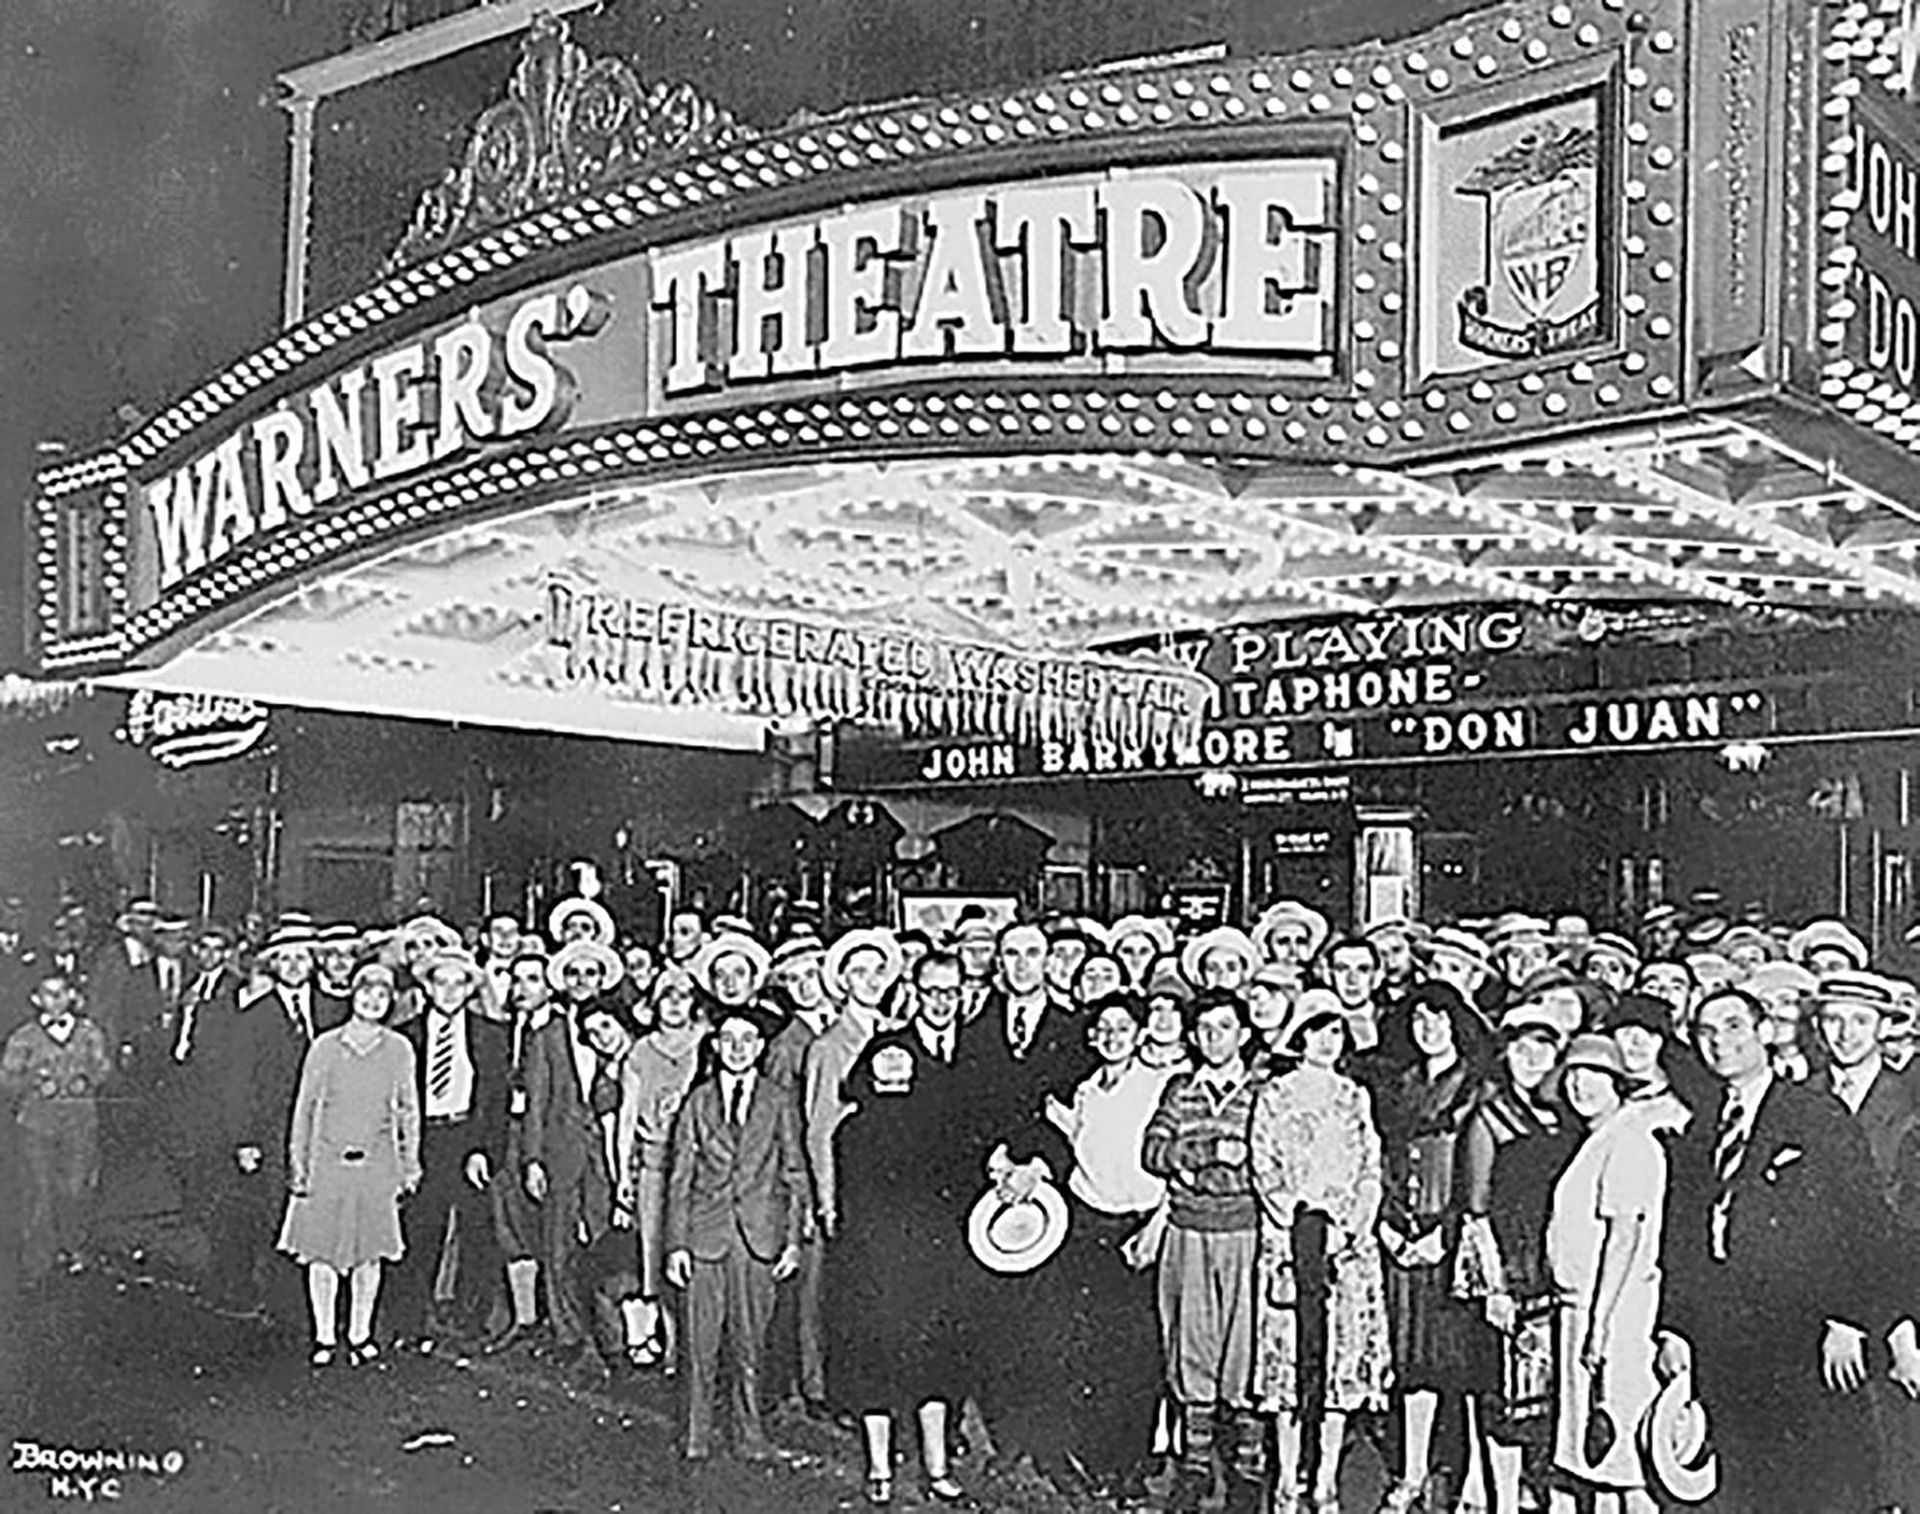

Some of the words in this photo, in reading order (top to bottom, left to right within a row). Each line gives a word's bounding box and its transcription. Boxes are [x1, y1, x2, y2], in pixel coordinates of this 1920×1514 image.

[652, 172, 1329, 392] THEATRE
[583, 595, 931, 680] REFRIGERATED
[1231, 612, 1524, 673] PLAYING
[922, 743, 1015, 779] JOHN
